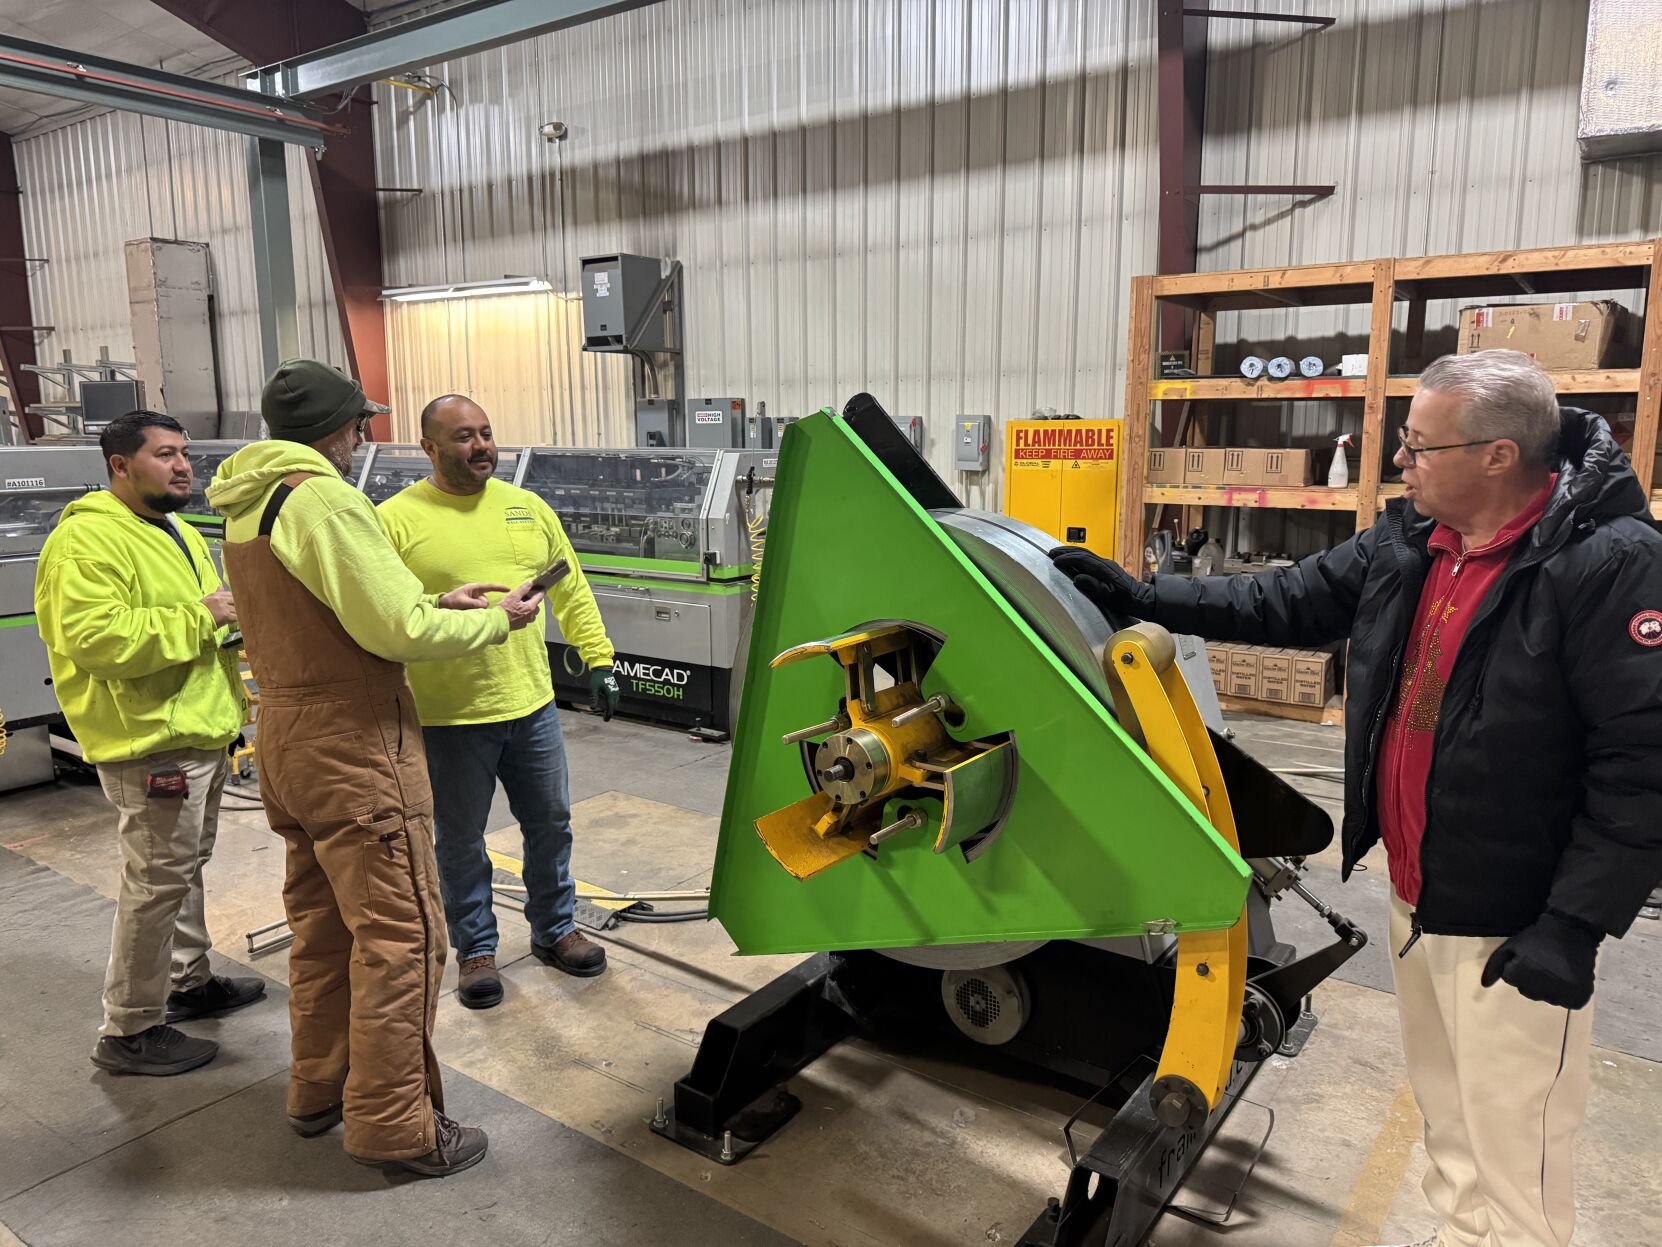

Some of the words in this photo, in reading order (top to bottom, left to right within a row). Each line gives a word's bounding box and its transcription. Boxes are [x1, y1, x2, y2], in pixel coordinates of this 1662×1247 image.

[1015, 428, 1115, 447] FLAMMABLE
[1019, 449, 1046, 458] KEEP
[1051, 449, 1075, 458] FIRE
[1080, 449, 1112, 458] AWAY
[630, 679, 683, 699] TF550H
